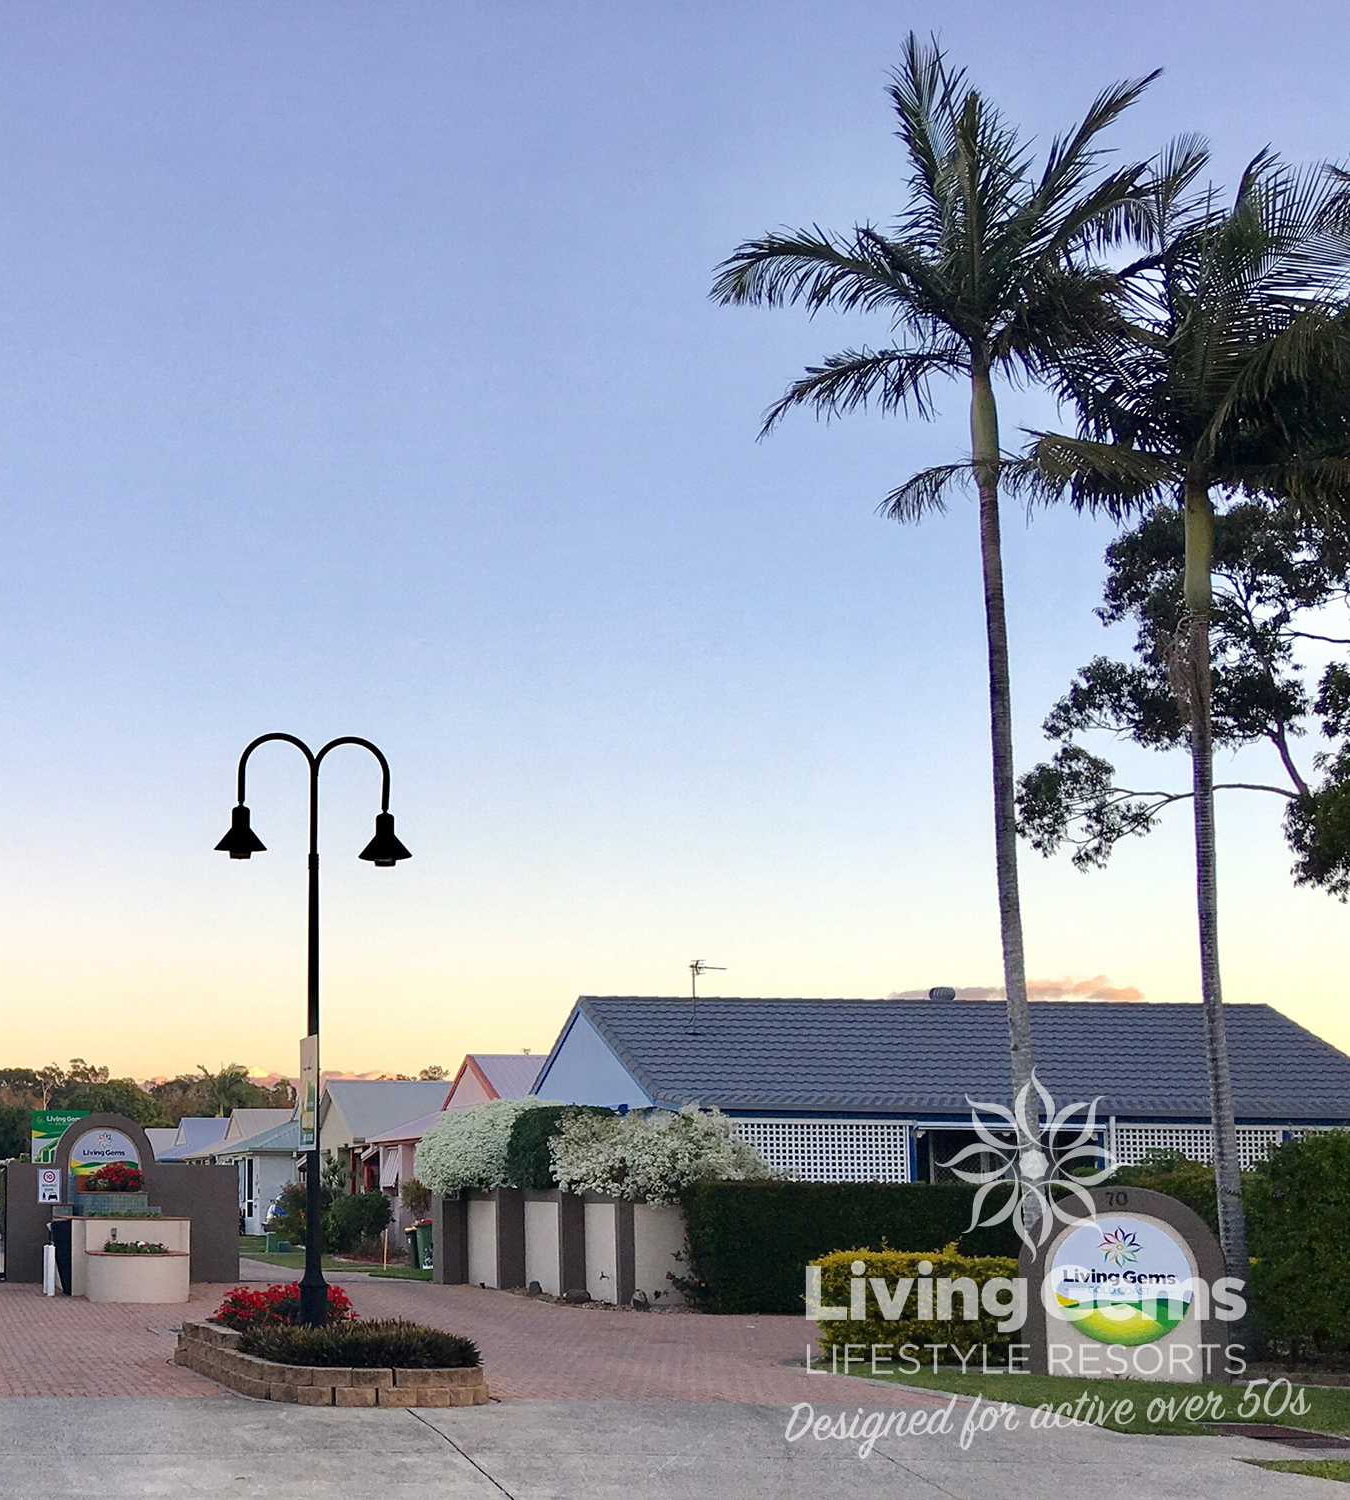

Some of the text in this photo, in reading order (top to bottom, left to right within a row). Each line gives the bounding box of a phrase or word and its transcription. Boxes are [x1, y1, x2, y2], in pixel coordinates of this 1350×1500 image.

[46, 1115, 66, 1123] Living
[82, 1149, 105, 1157] Living
[1104, 1191, 1129, 1206] 70
[1063, 1268, 1178, 1287] Living Gems
[1087, 1285, 1151, 1297] GOLD COAST
